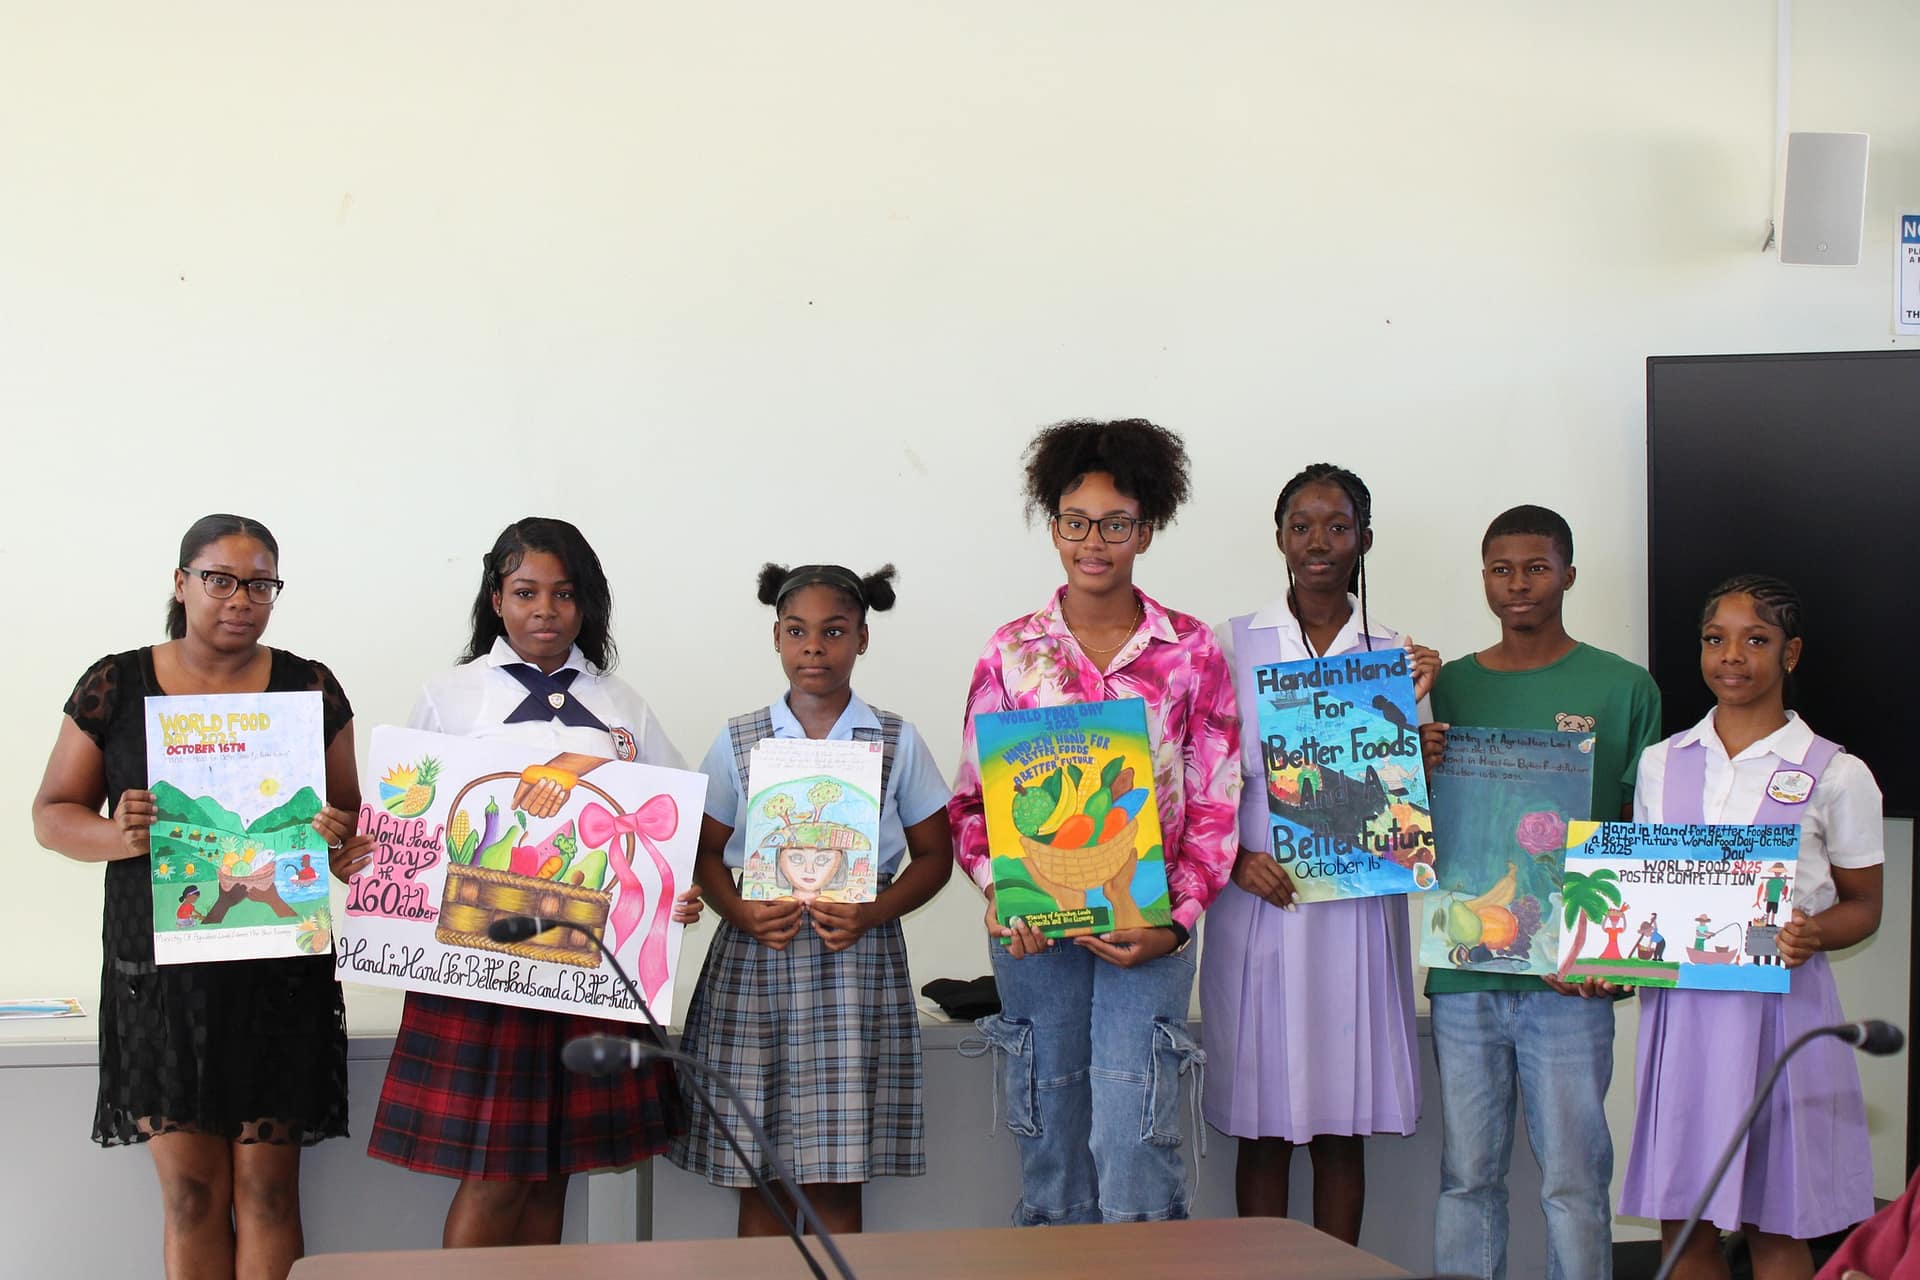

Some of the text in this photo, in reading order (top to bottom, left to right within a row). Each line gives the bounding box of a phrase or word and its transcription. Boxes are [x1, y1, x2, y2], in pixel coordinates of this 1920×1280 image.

[1908, 247, 1920, 255] PL
[1256, 653, 1408, 694] Hand in Hand
[1313, 691, 1354, 719] For
[159, 712, 271, 734] WORLD FOOD
[998, 709, 1041, 726] WORLD
[166, 744, 216, 756] OCTOBER
[1054, 733, 1086, 745] HAND
[1090, 733, 1110, 750] FOR
[1268, 727, 1418, 771] Better Foods
[1020, 744, 1089, 766] BETTER FOODS
[1020, 760, 1057, 781] BETTER
[1060, 756, 1094, 767] FUTURE
[1363, 765, 1390, 803] A
[360, 807, 409, 845] World
[1602, 822, 1636, 834] Hand
[1639, 823, 1649, 836] in
[1653, 824, 1688, 836] Hand
[1708, 825, 1745, 837] Better
[1747, 825, 1772, 837] Foods
[1774, 824, 1795, 837] and
[1273, 815, 1435, 864] Better Future
[1592, 836, 1600, 844] a
[1602, 833, 1640, 846] Better
[1642, 834, 1678, 847] Future
[1682, 834, 1714, 847] World
[1715, 836, 1736, 847] Food
[1601, 843, 1632, 856] 2025
[377, 843, 437, 879] Day
[1721, 846, 1745, 862] Day
[1295, 856, 1363, 879] October
[1619, 869, 1756, 886] POSTER COMPETITION
[1644, 860, 1762, 874] WORLD FOOD 2025
[380, 882, 439, 920] October
[337, 937, 390, 975] Hand
[388, 953, 402, 976] in
[399, 946, 450, 982] Hand
[443, 952, 468, 985] for
[465, 955, 507, 992] Better
[536, 969, 567, 999] and
[561, 990, 573, 1001] a
[572, 971, 609, 1004] Better
